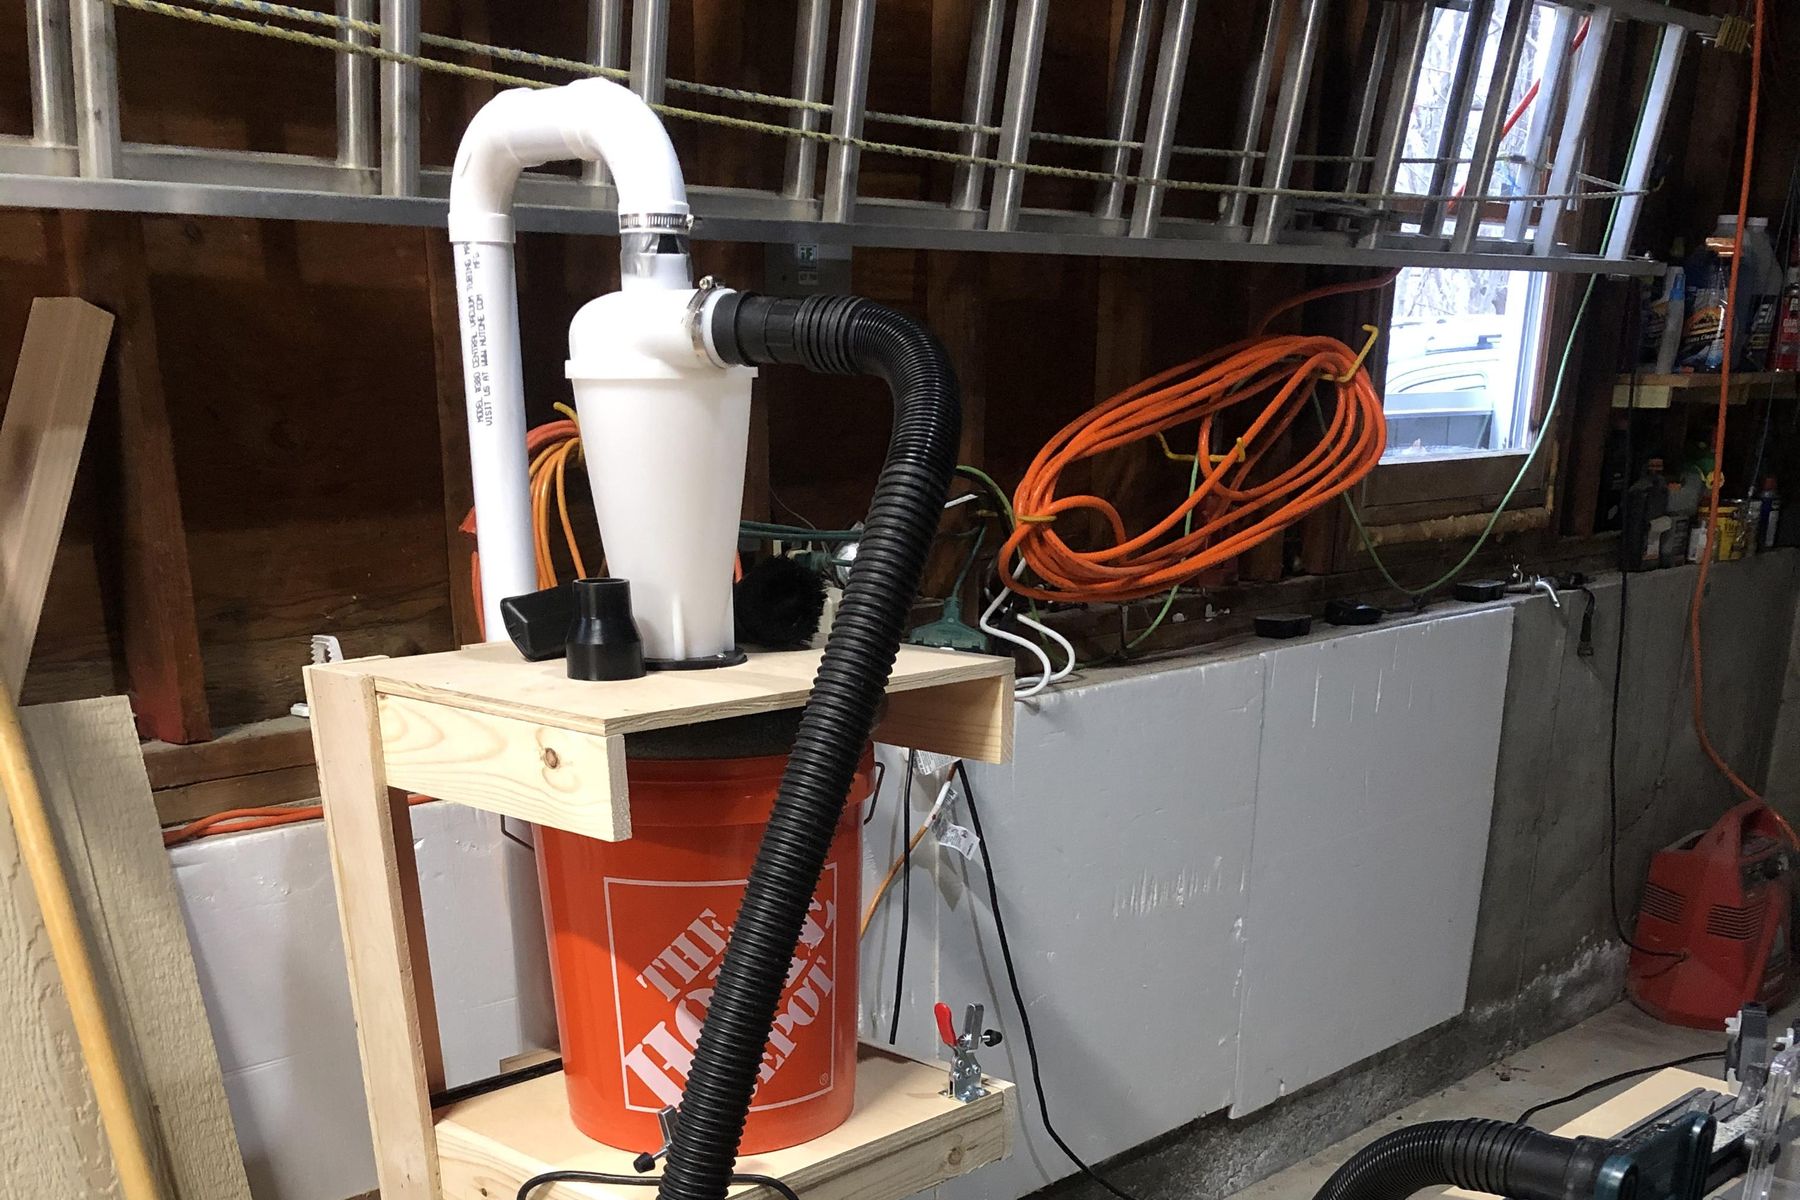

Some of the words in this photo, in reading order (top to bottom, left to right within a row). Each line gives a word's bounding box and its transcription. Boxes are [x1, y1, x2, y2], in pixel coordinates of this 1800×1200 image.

[464, 259, 474, 292] TUBING
[467, 295, 477, 328] VACUUM
[471, 332, 480, 369] CENTRAL
[481, 371, 489, 381] AT
[483, 385, 491, 397] US
[475, 397, 484, 423] MODEL
[484, 402, 493, 426] VISIT
[636, 907, 733, 1003] THE
[750, 956, 835, 1099] EPOT
